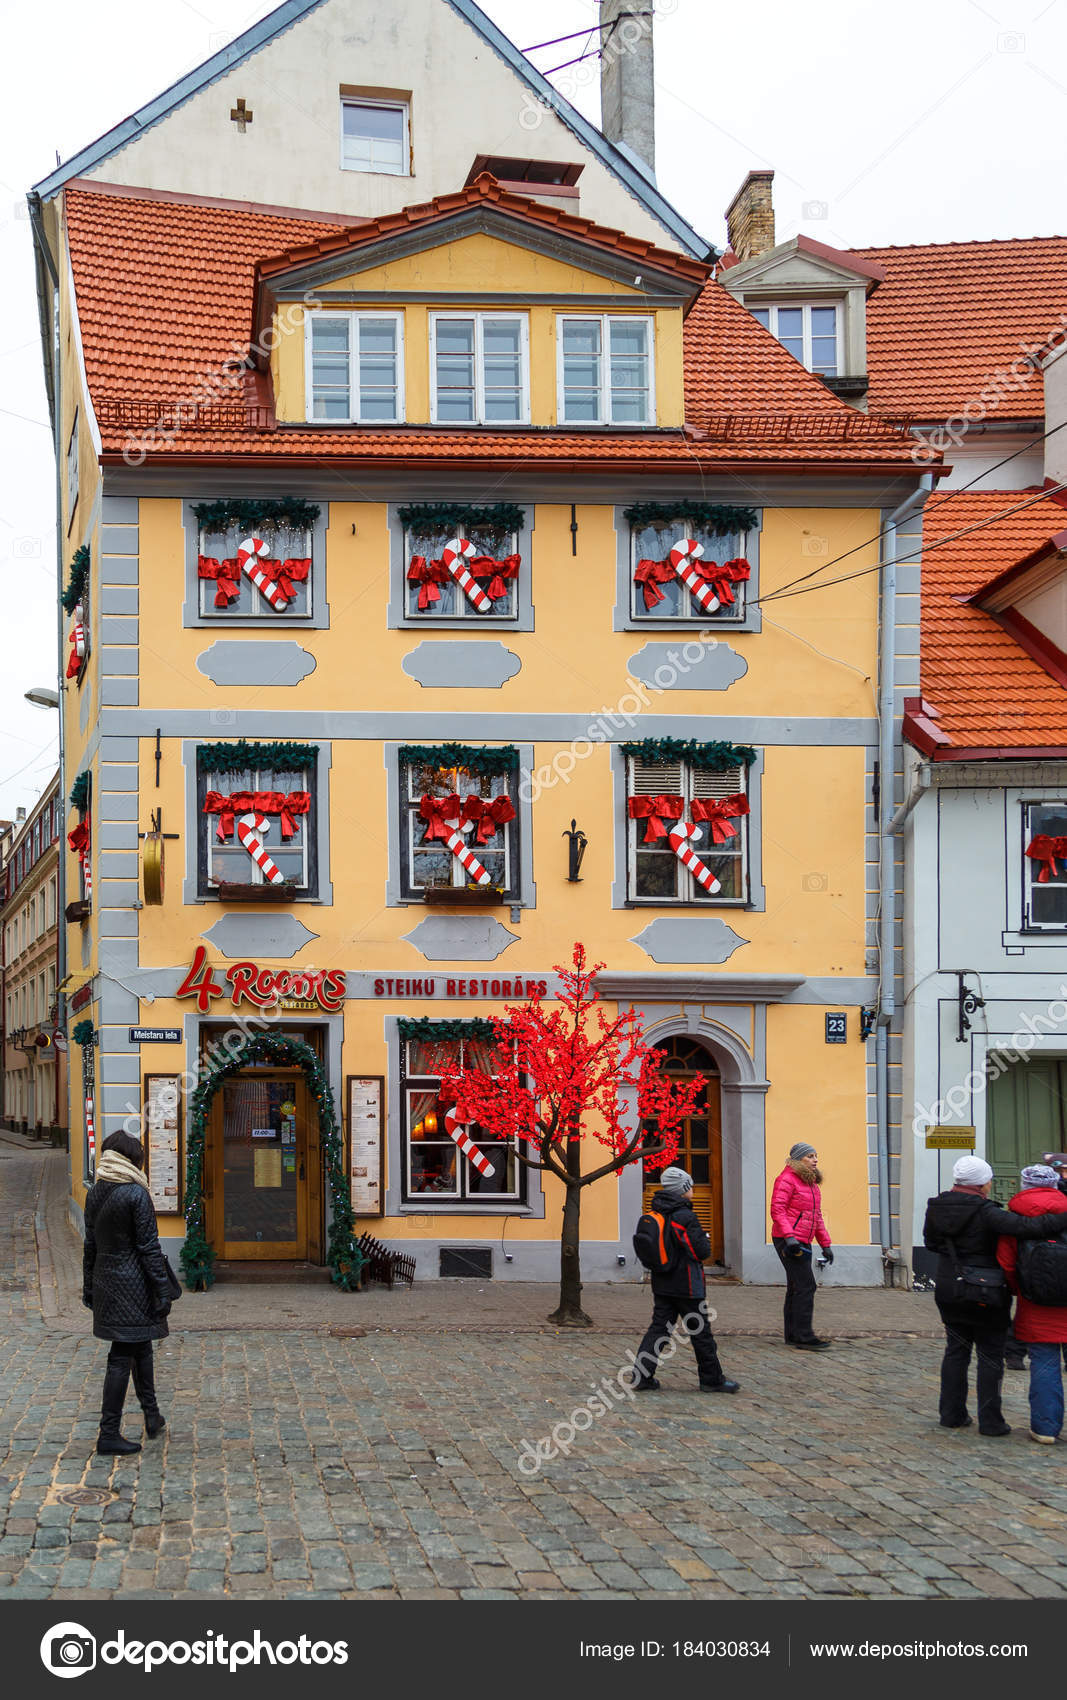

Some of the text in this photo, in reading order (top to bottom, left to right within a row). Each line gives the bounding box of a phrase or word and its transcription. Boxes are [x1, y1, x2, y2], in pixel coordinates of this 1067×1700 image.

[176, 945, 224, 1013] 4
[374, 978, 434, 995] STEIKU
[829, 1019, 845, 1032] 23
[134, 1030, 164, 1039] Meistaru
